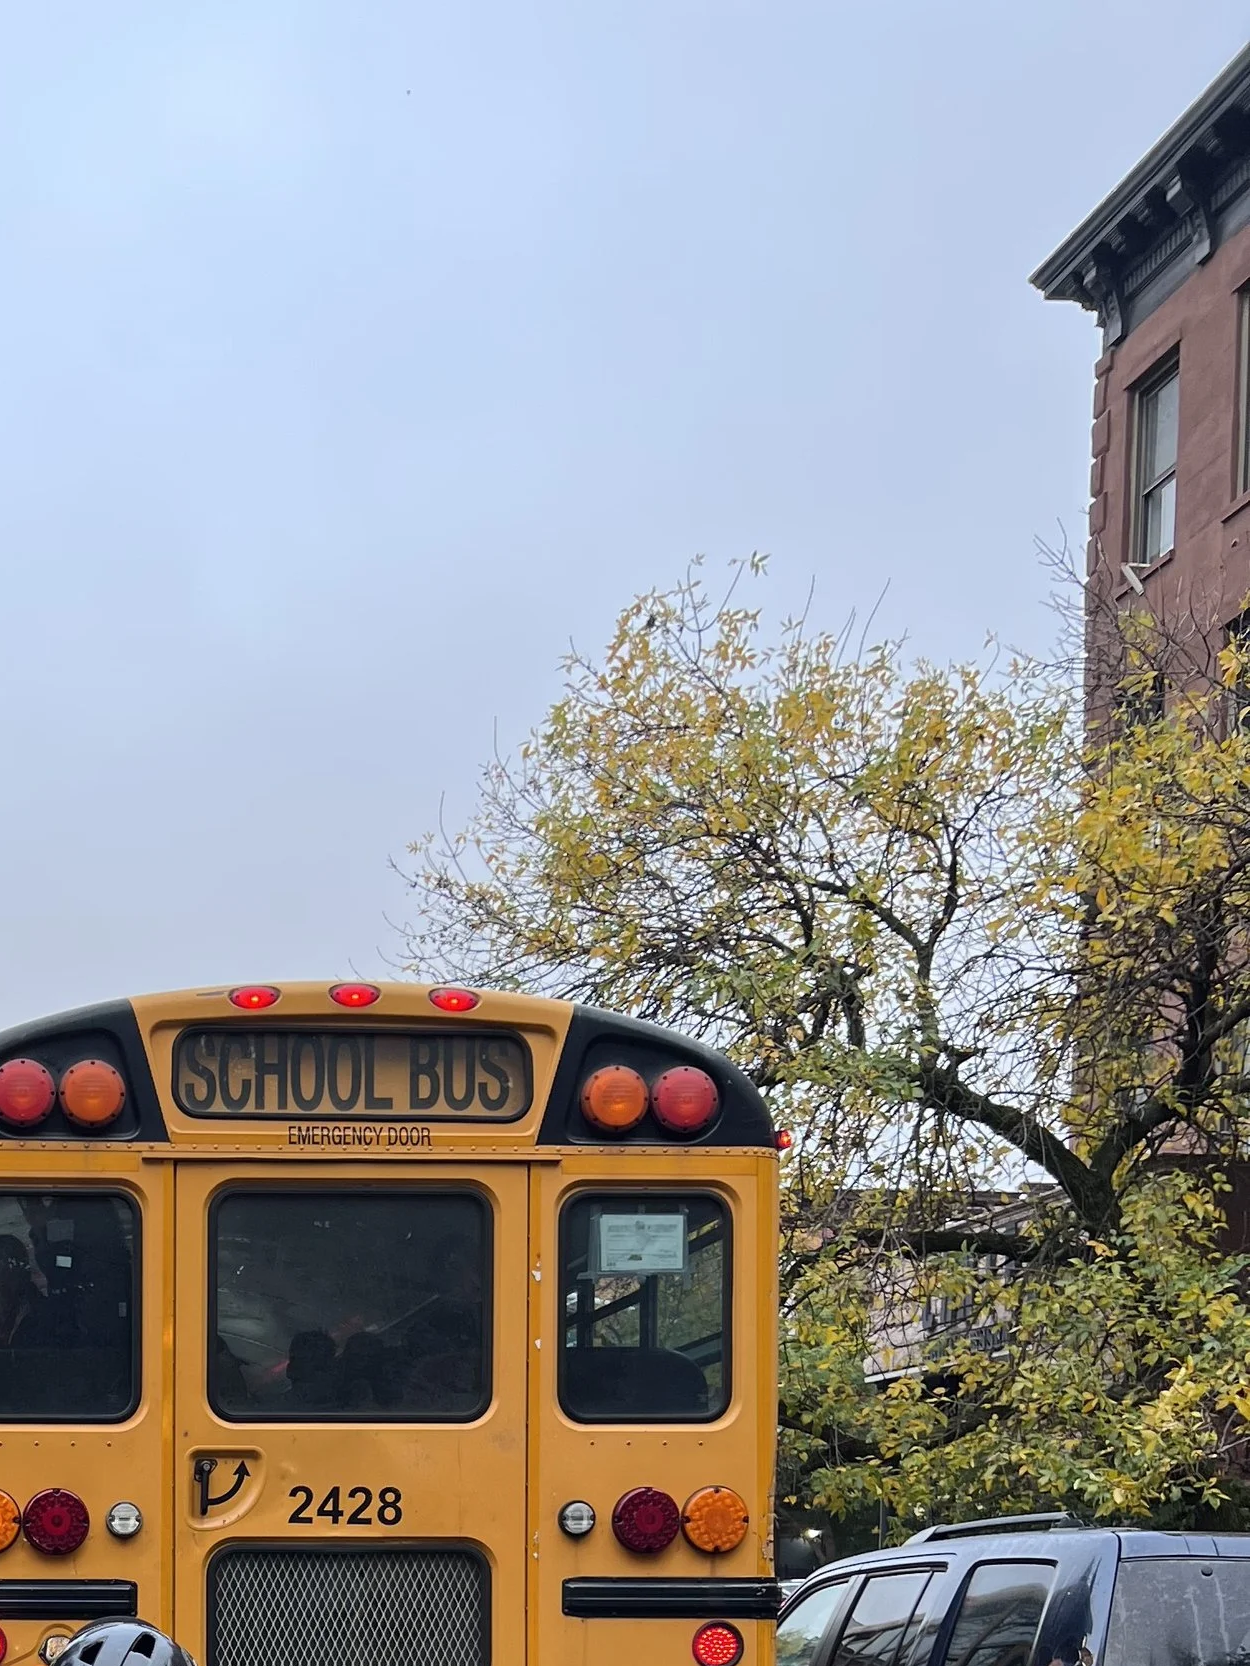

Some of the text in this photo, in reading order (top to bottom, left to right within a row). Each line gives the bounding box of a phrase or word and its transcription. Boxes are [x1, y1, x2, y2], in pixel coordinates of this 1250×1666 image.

[184, 1033, 510, 1112] SCHOOL BUS
[288, 1126, 432, 1147] EMERGENCY DOOR
[287, 1485, 403, 1526] 2428
